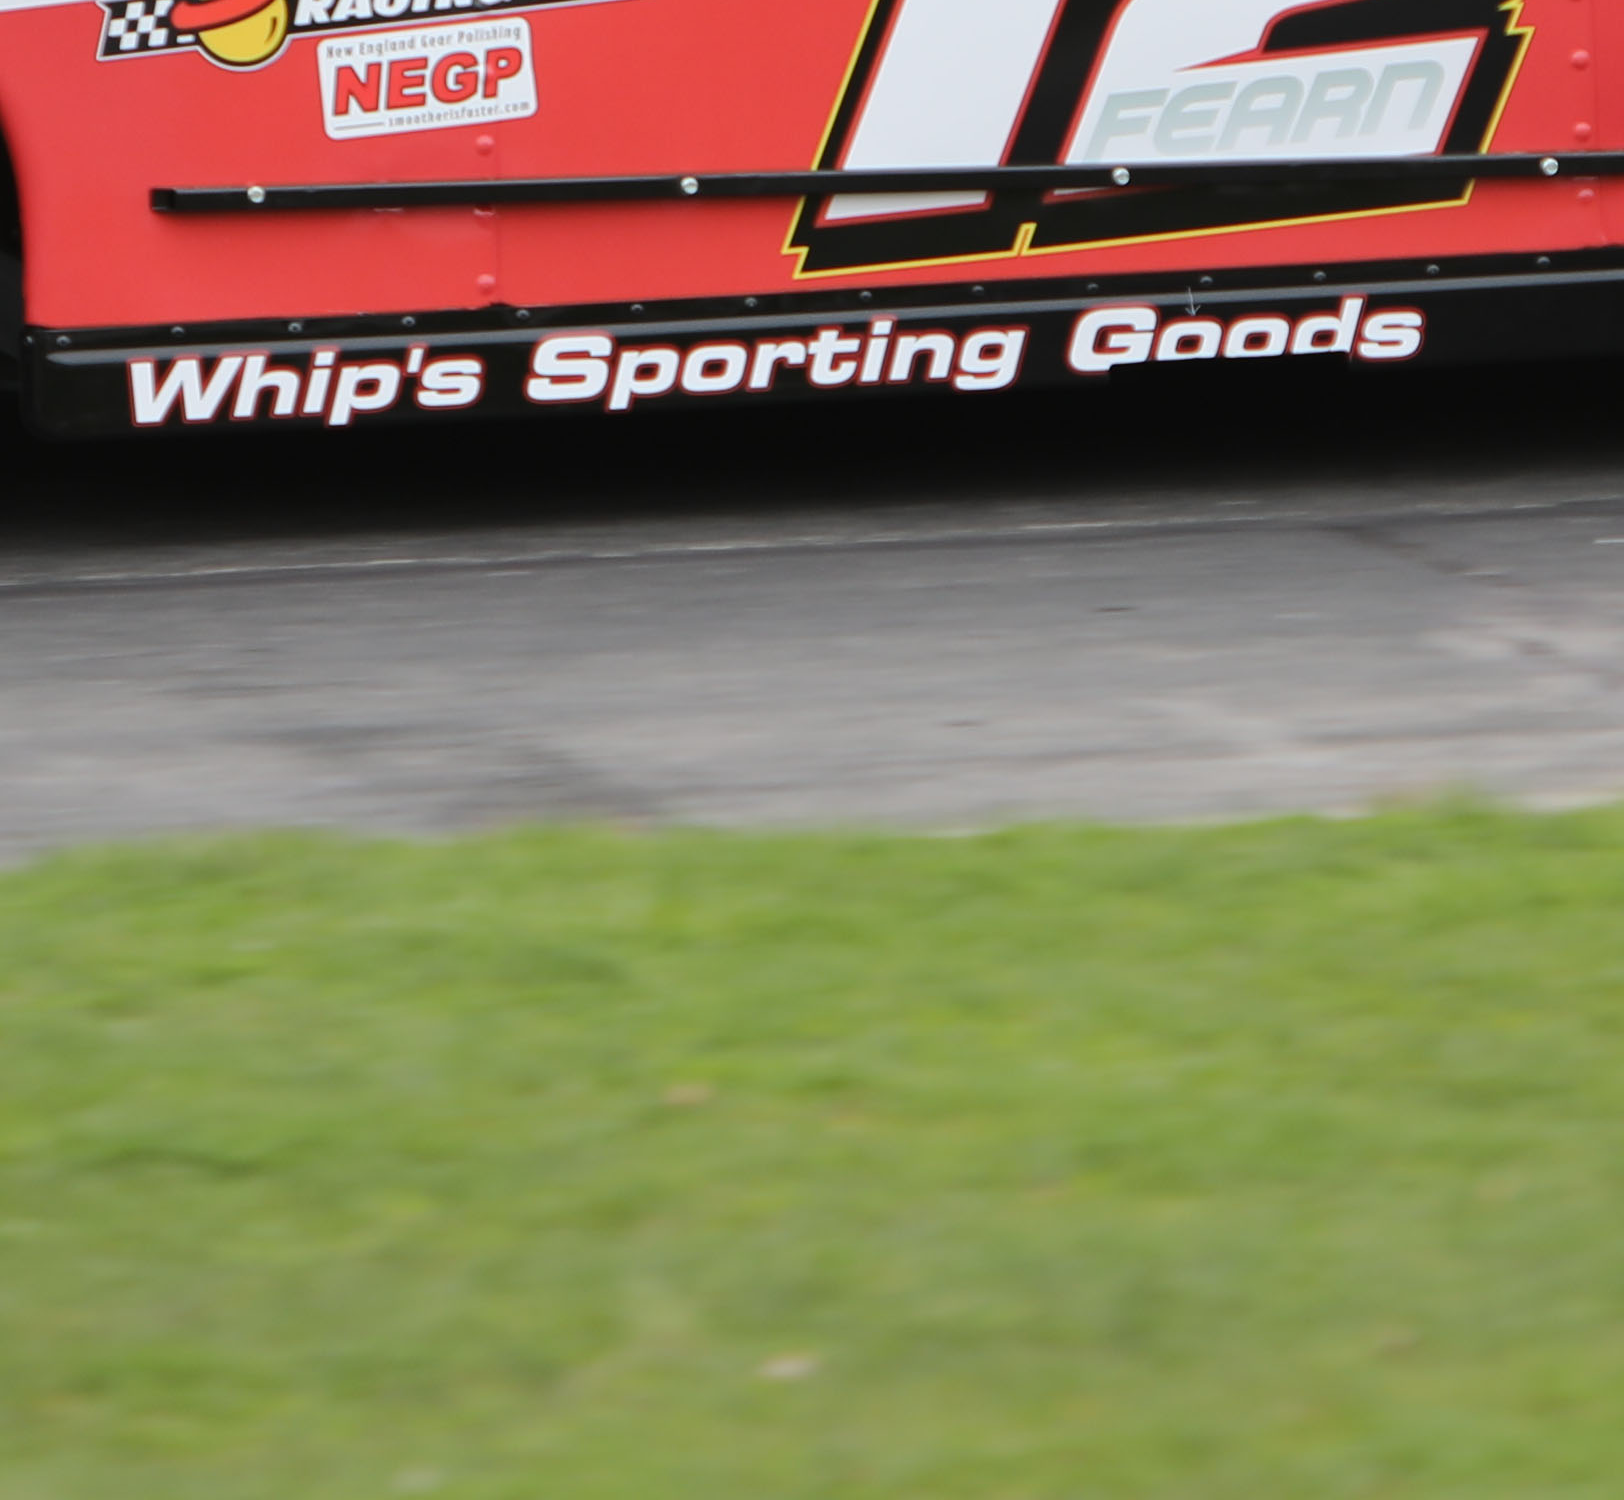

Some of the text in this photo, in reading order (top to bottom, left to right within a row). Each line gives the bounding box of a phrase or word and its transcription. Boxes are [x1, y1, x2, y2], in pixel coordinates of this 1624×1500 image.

[326, 25, 523, 59] New England Gear Polishing
[332, 45, 524, 117] NEGP
[387, 100, 531, 128] smootherisfaster.com
[1080, 58, 1446, 164] FEARN
[128, 294, 1426, 428] Whip's Sporting Goods
